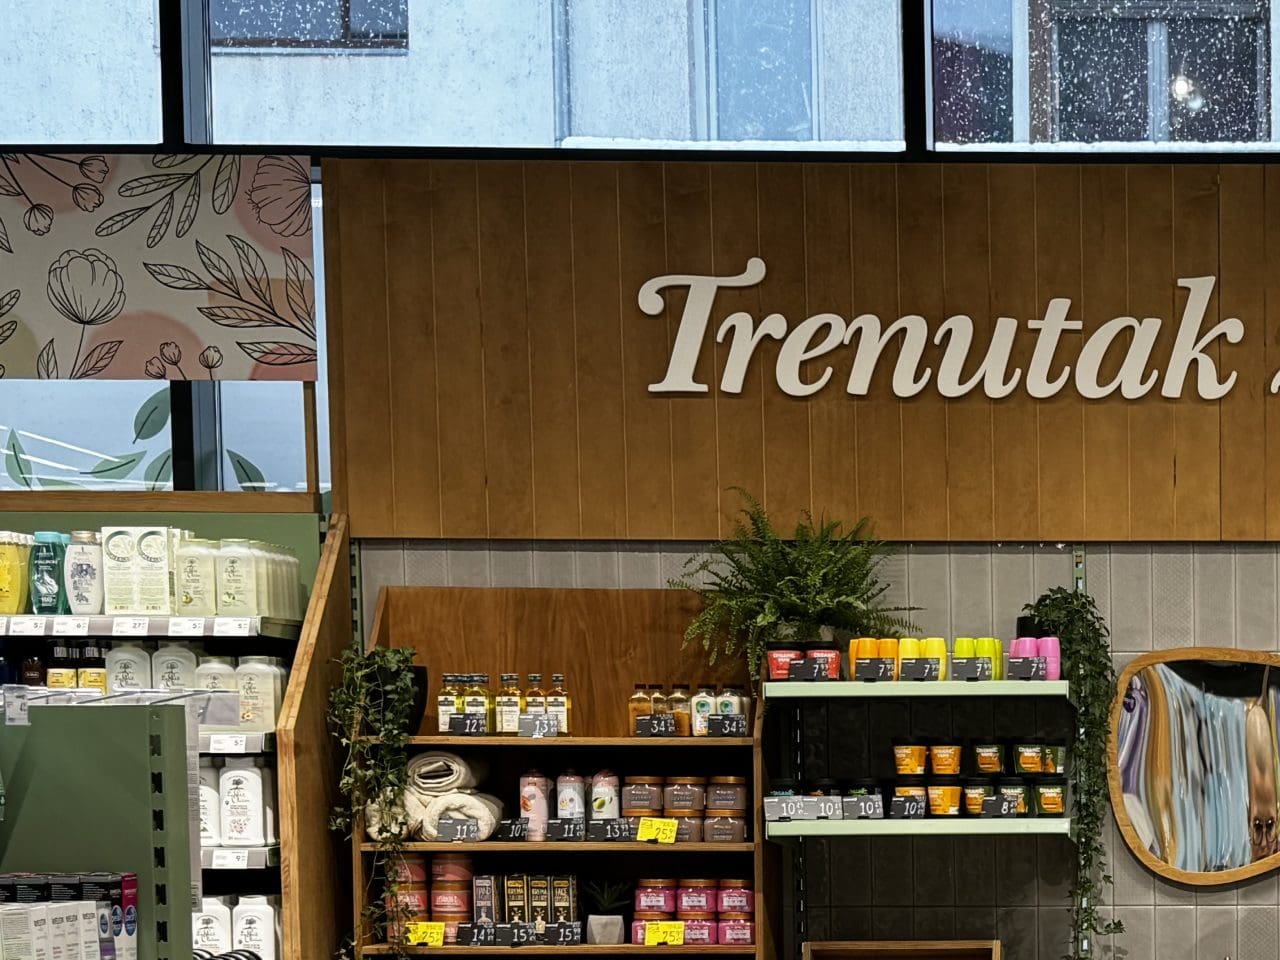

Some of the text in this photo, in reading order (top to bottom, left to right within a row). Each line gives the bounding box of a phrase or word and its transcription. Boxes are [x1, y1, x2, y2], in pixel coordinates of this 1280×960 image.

[639, 257, 1246, 400] Trenutak
[781, 803, 796, 815] 10
[820, 803, 834, 815] 10
[859, 802, 873, 814] 10
[1001, 802, 1008, 814] 8
[472, 929, 485, 942] 14
[513, 929, 527, 942] 15
[560, 929, 572, 941] 15
